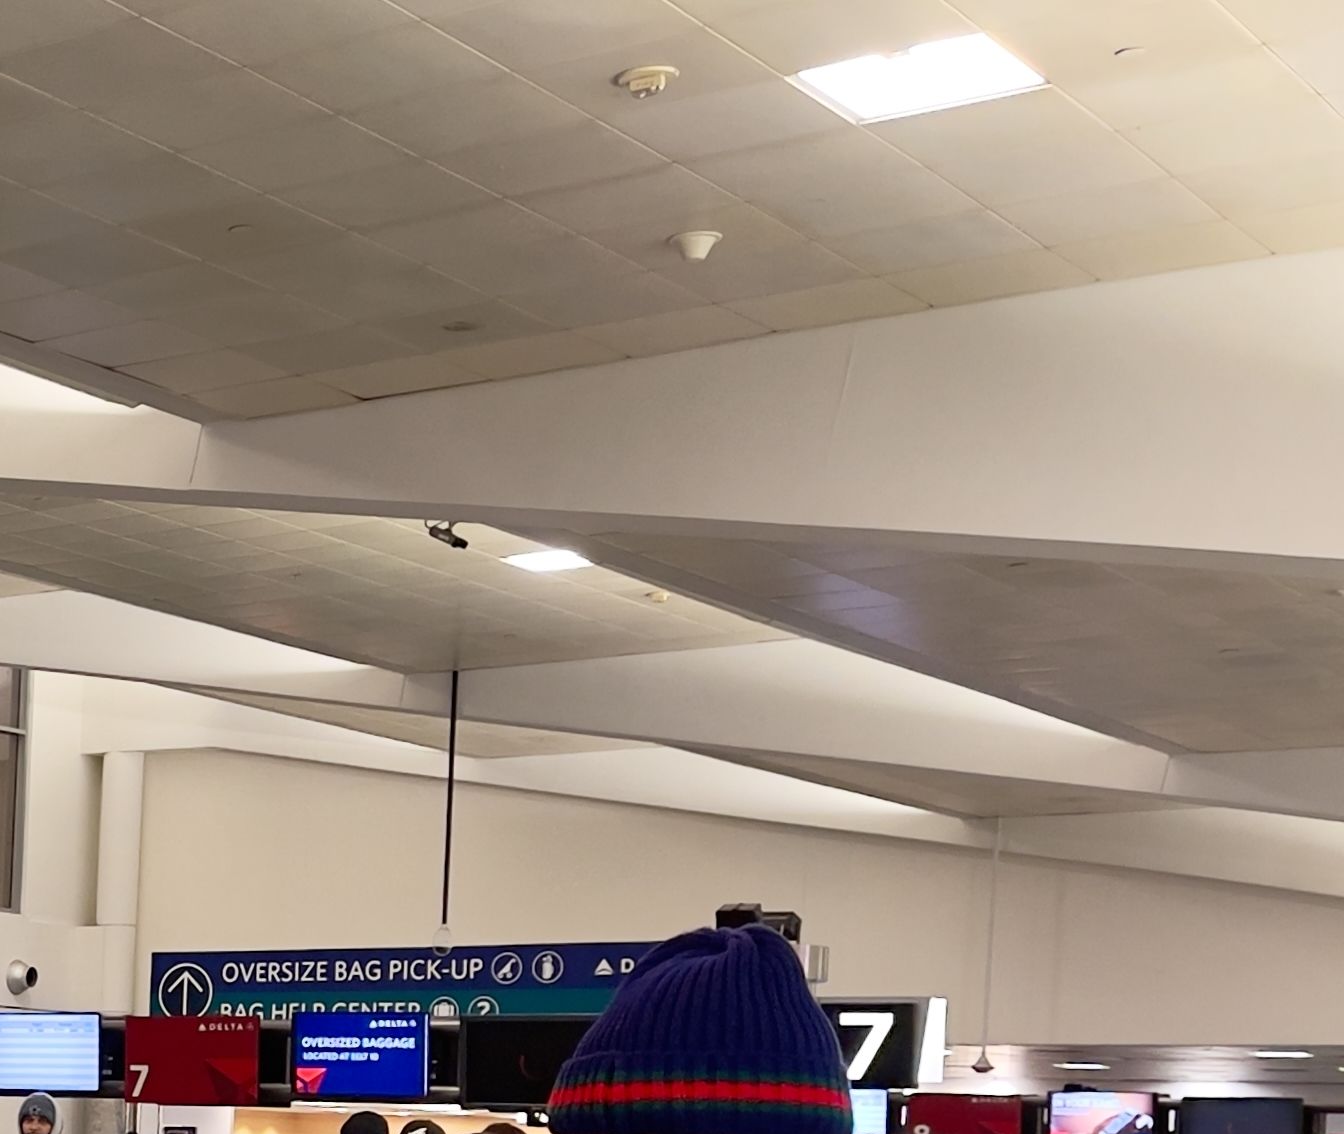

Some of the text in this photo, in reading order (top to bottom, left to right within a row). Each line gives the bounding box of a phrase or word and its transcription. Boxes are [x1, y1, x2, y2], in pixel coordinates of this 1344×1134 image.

[221, 961, 328, 983] OVERSIZE
[334, 960, 382, 982] BAG
[389, 957, 484, 981] PICK-UP
[208, 1022, 244, 1032] DELTA
[301, 1036, 416, 1050] OVERSIZED BAGGAGE
[838, 1011, 895, 1081] 7
[129, 1064, 150, 1098] 7
